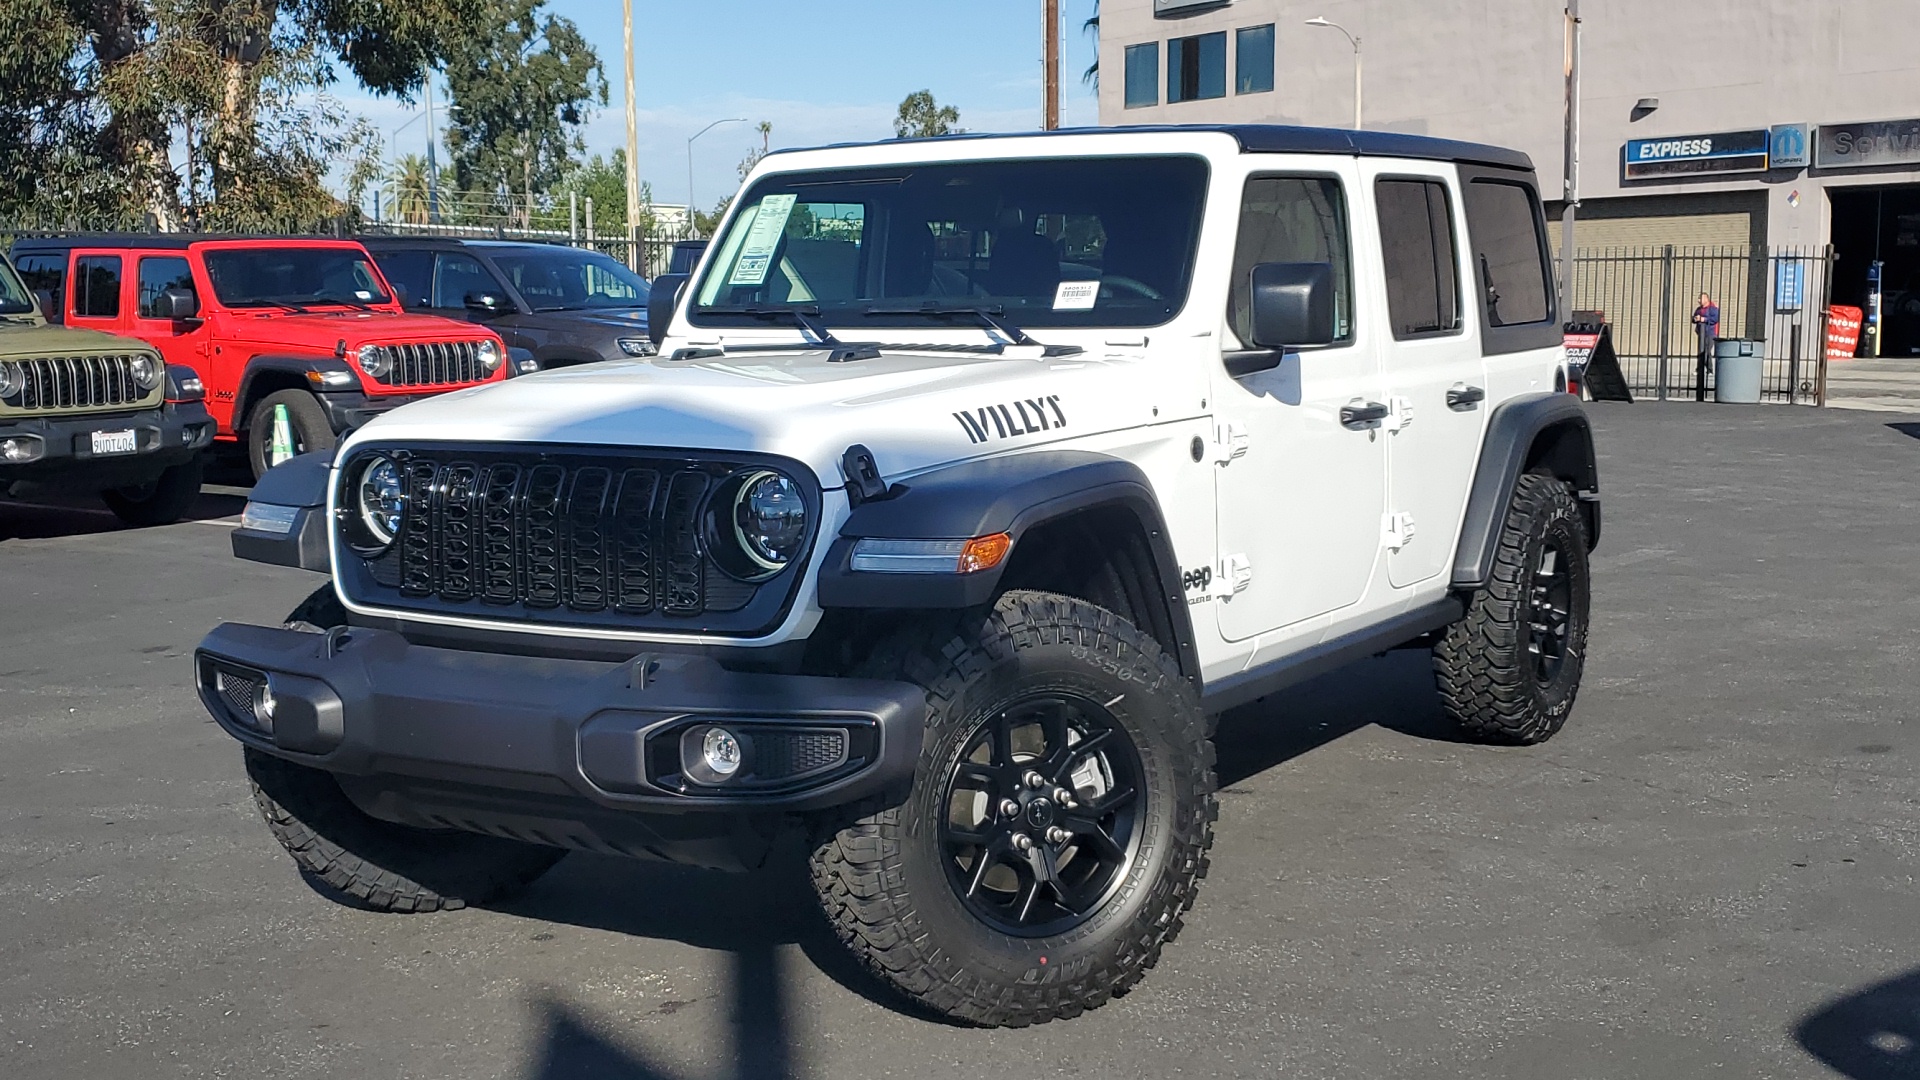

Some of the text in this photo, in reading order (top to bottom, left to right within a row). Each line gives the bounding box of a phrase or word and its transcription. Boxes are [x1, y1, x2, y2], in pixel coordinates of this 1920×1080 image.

[1639, 139, 1713, 159] EXPRESS
[1566, 348, 1591, 357] CDJR
[1568, 356, 1588, 365] KING
[951, 394, 1067, 444] WILLYS
[93, 437, 134, 454] 9UDT406
[1180, 565, 1212, 592] eep
